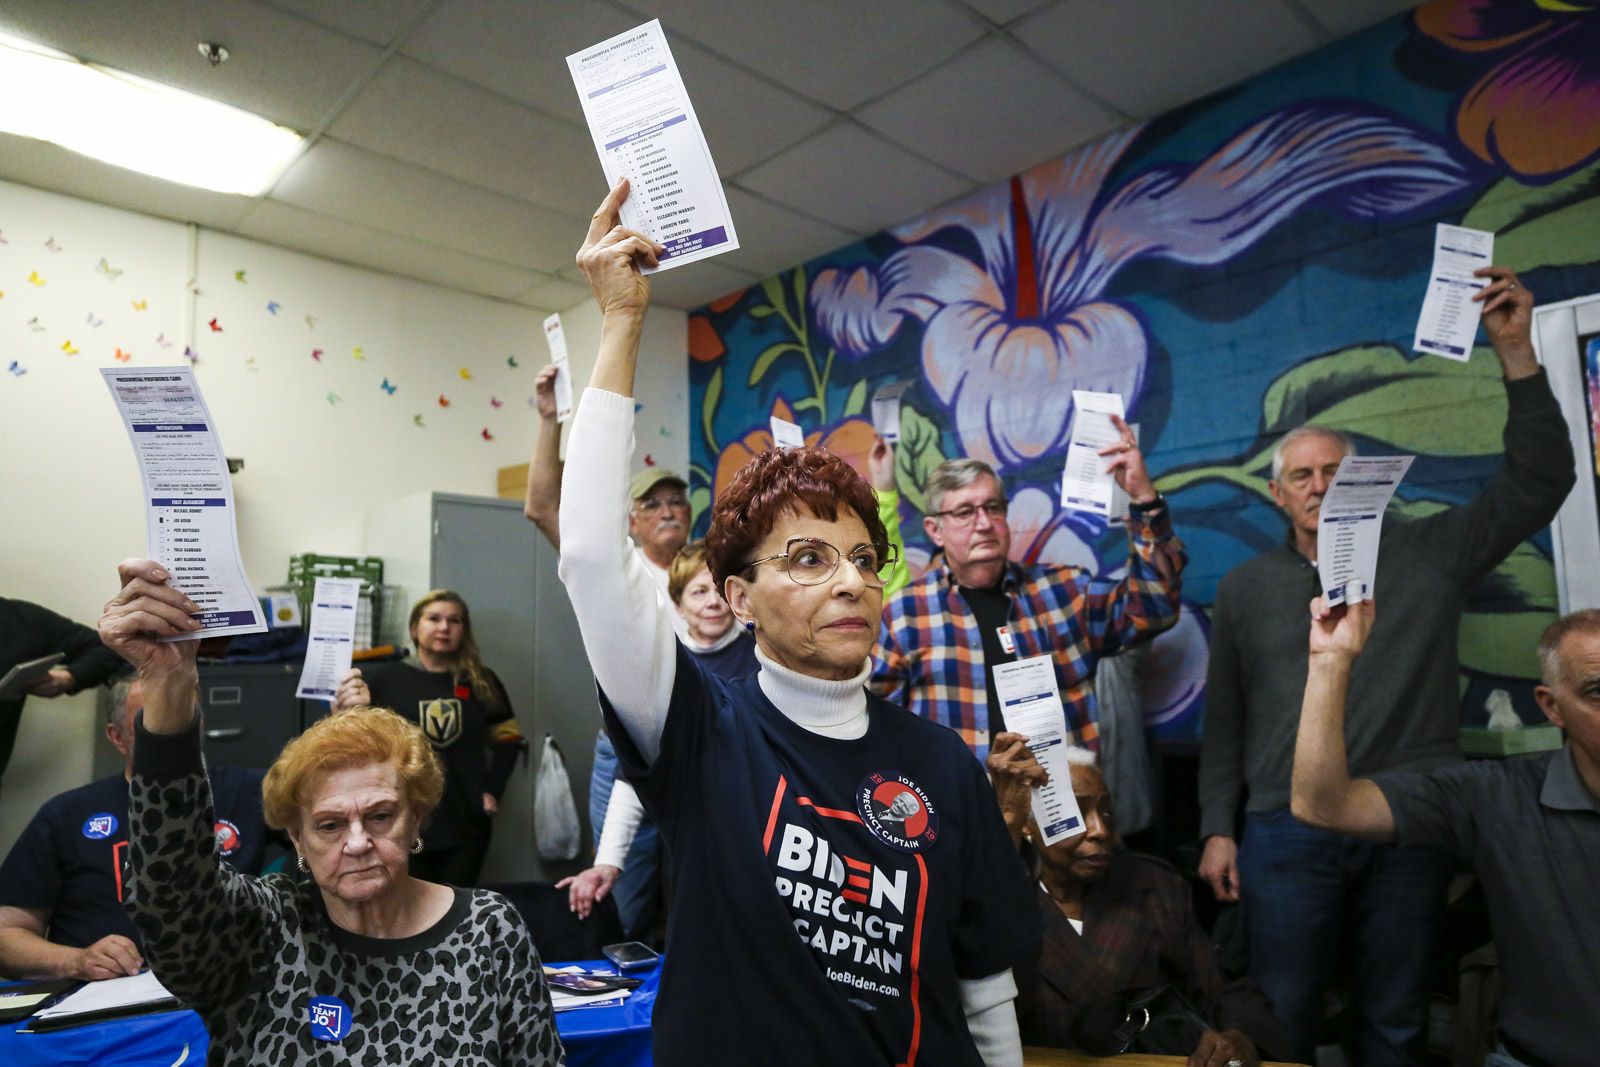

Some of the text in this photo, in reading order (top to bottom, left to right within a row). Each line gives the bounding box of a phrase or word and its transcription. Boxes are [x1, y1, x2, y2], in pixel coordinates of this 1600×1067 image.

[581, 48, 610, 63] PRESIDENTIAL
[610, 37, 636, 51] PREFERENCE
[636, 32, 648, 40] CARD
[631, 137, 648, 146] MICHAEL
[650, 156, 667, 165] DELANEY
[653, 163, 672, 173] GABBARD
[655, 170, 679, 181] KLOBUCHAR
[648, 180, 677, 194] DEVAL PATRICK
[650, 188, 683, 202] BERNIE SANDERS
[663, 200, 678, 208] STEYER
[656, 206, 696, 221] ELIZABETH WARREN
[660, 222, 678, 230] ANDREW
[663, 228, 692, 240] UNCOMMITTED
[898, 776, 934, 814] JOE BIDEN
[862, 788, 920, 848] PRECINCT CAPTAIN
[925, 829, 936, 840] 20
[777, 823, 908, 915] BIDEN
[775, 876, 904, 946] PRECNCT
[312, 1006, 336, 1018] TEAM
[312, 1014, 336, 1026] JOE
